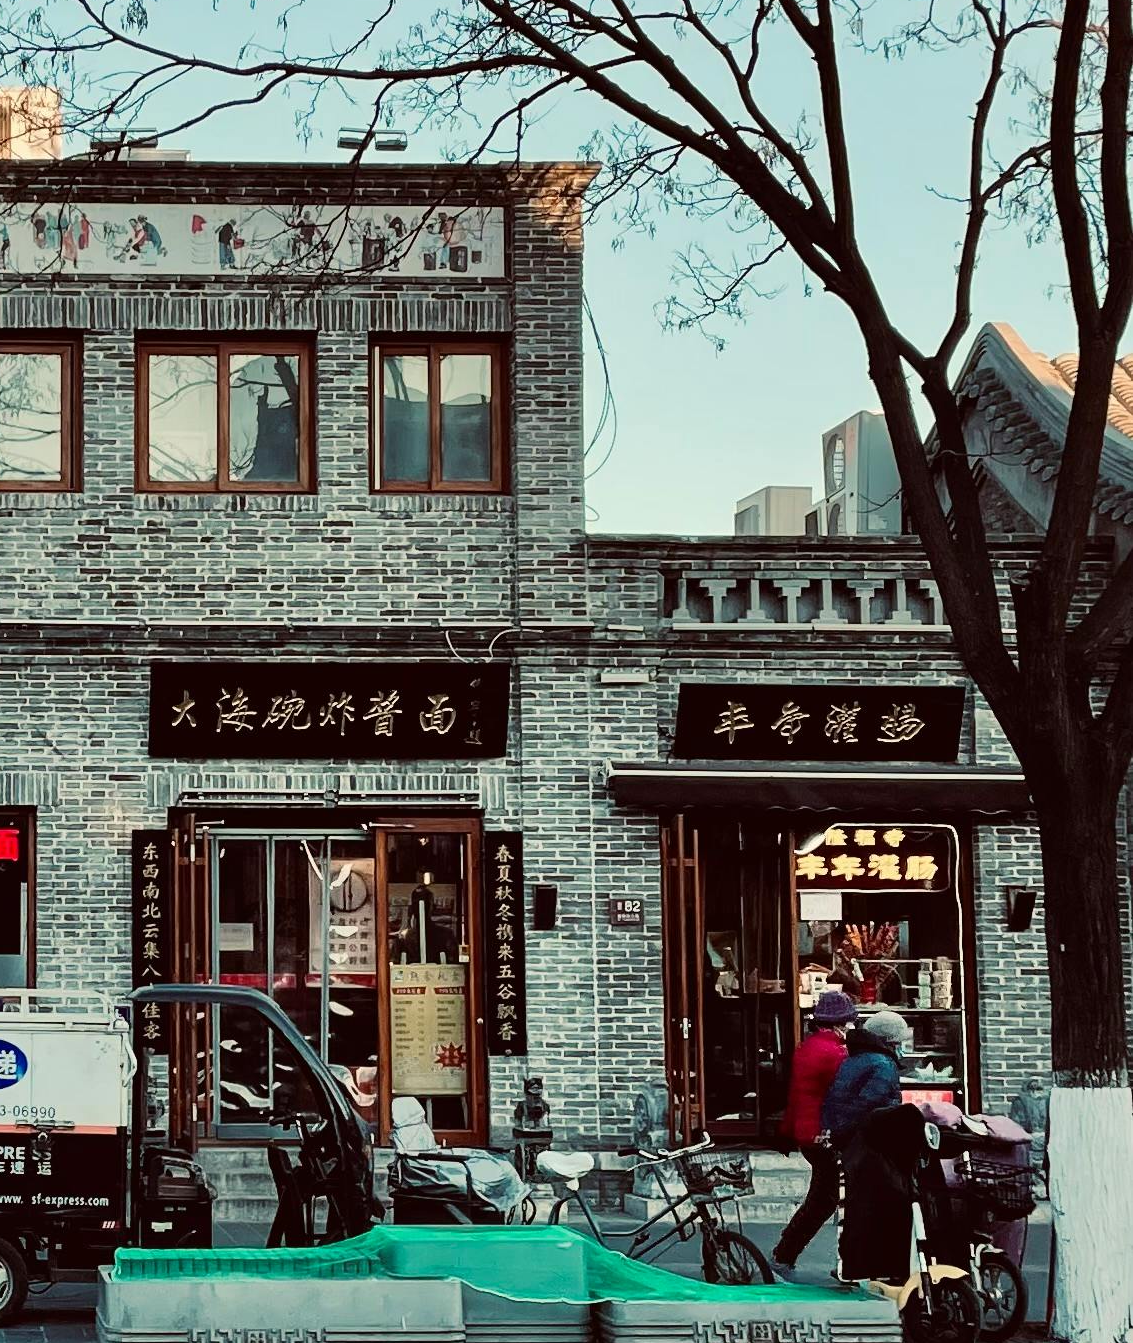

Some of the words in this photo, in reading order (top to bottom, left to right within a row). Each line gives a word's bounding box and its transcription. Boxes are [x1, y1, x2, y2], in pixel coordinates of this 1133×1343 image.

[141, 842, 162, 1039] 东西南北云集八佳客
